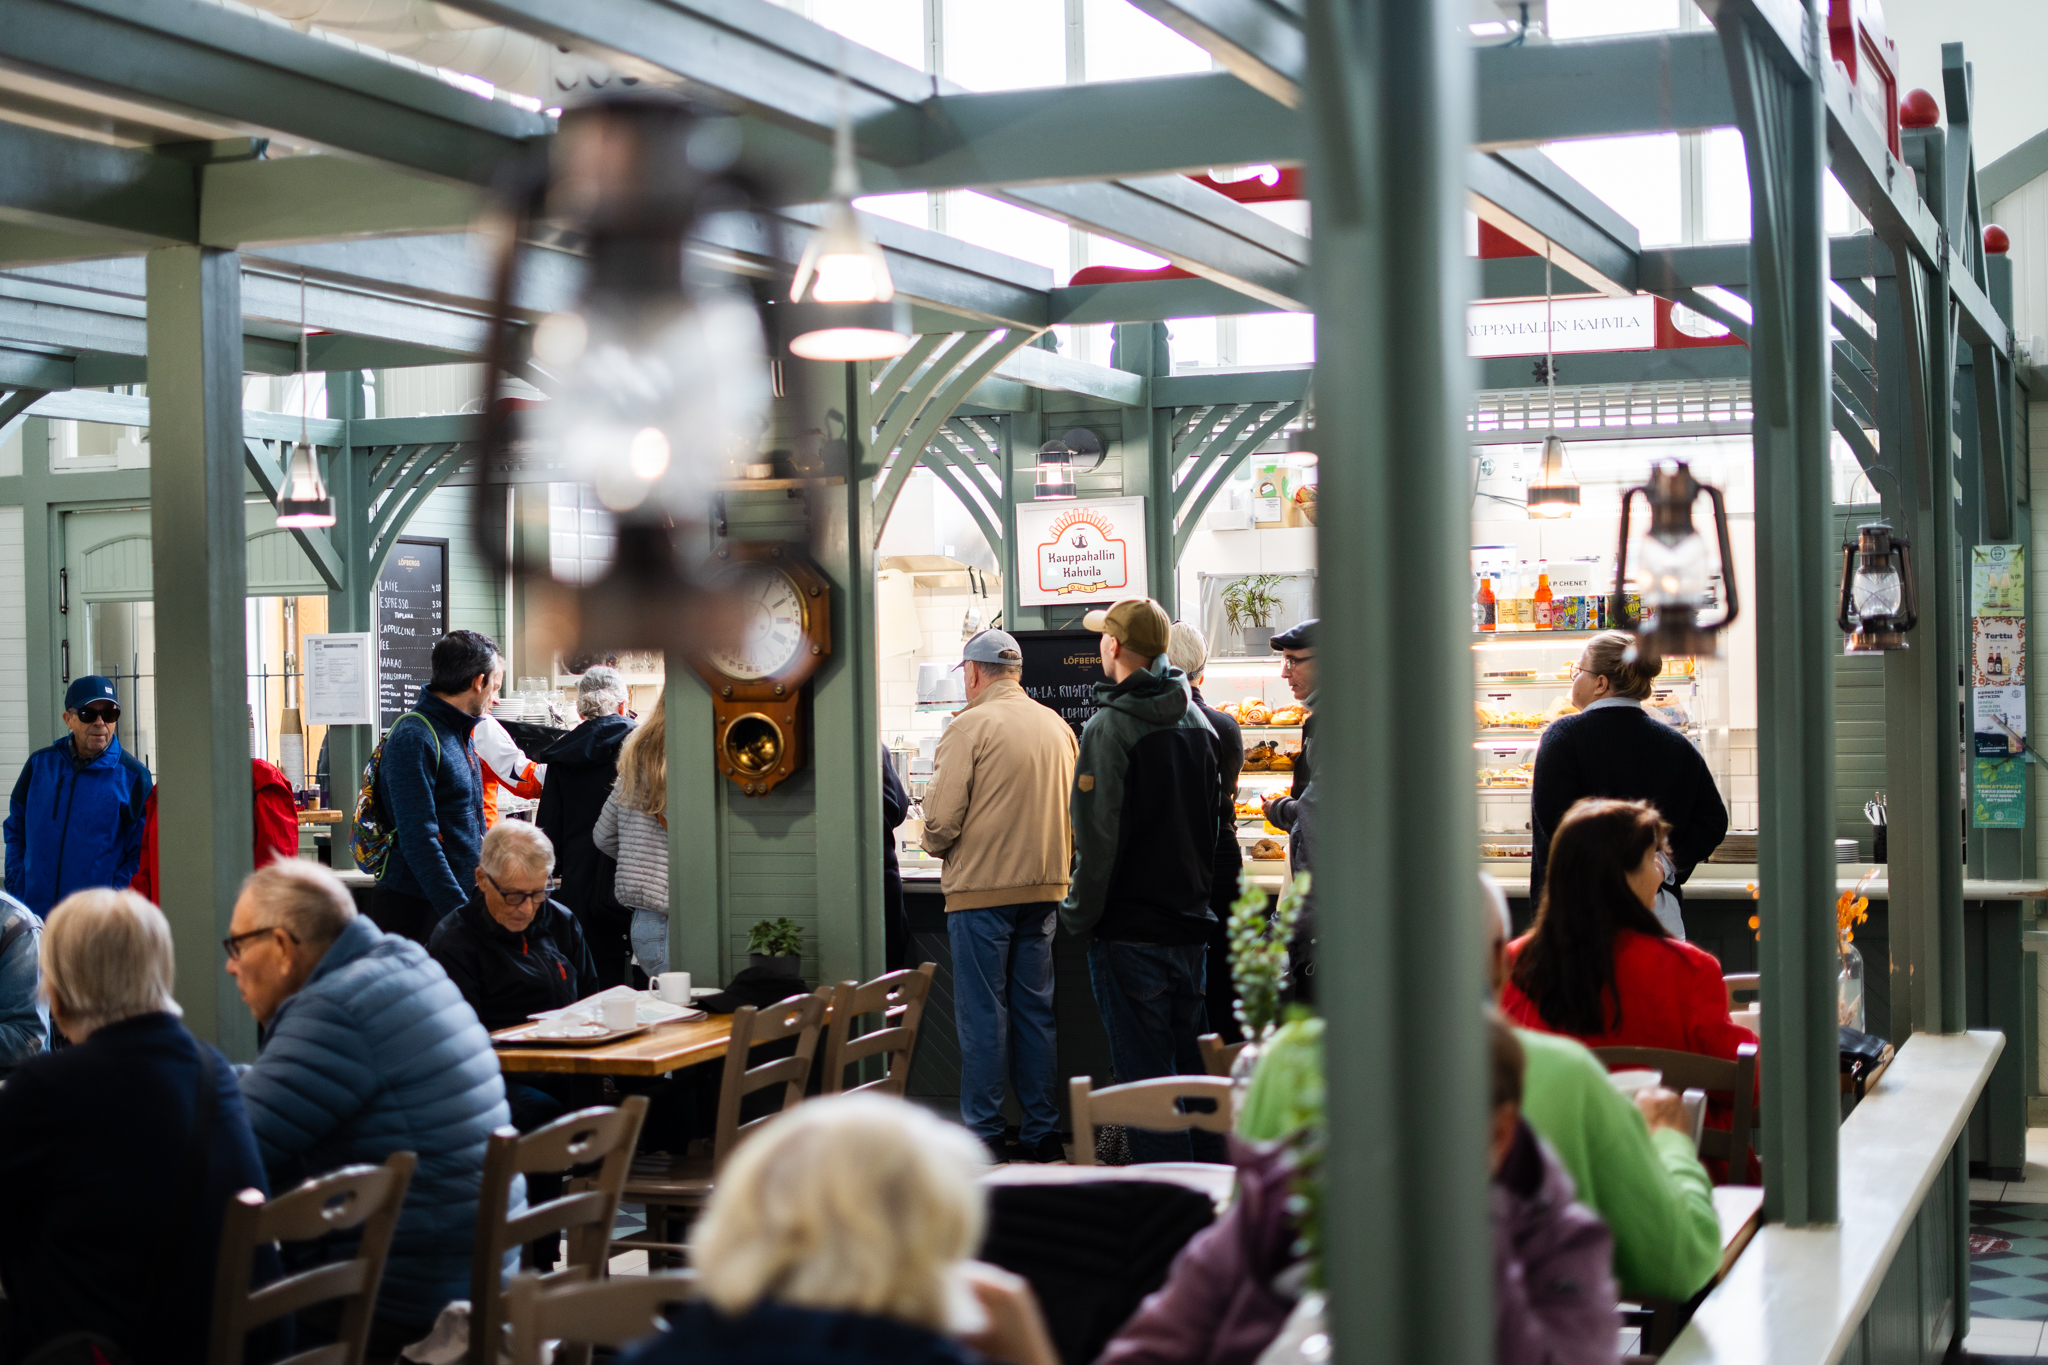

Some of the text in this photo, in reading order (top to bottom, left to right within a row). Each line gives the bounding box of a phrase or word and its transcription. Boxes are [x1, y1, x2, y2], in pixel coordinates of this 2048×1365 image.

[1465, 316, 1640, 336] AUPPAHALLIN KAHVILA
[398, 558, 420, 567] LÖFBERGS
[1048, 550, 1115, 565] Kauppahallin
[1063, 566, 1102, 578] Kahvila
[380, 580, 398, 592] LATTE
[380, 597, 409, 609] ESPRESSO
[1624, 602, 1640, 614] TRIP
[1564, 605, 1578, 616] TRIP
[380, 625, 415, 636] CAPPUCCINO
[1063, 656, 1102, 665] LÖFBERG
